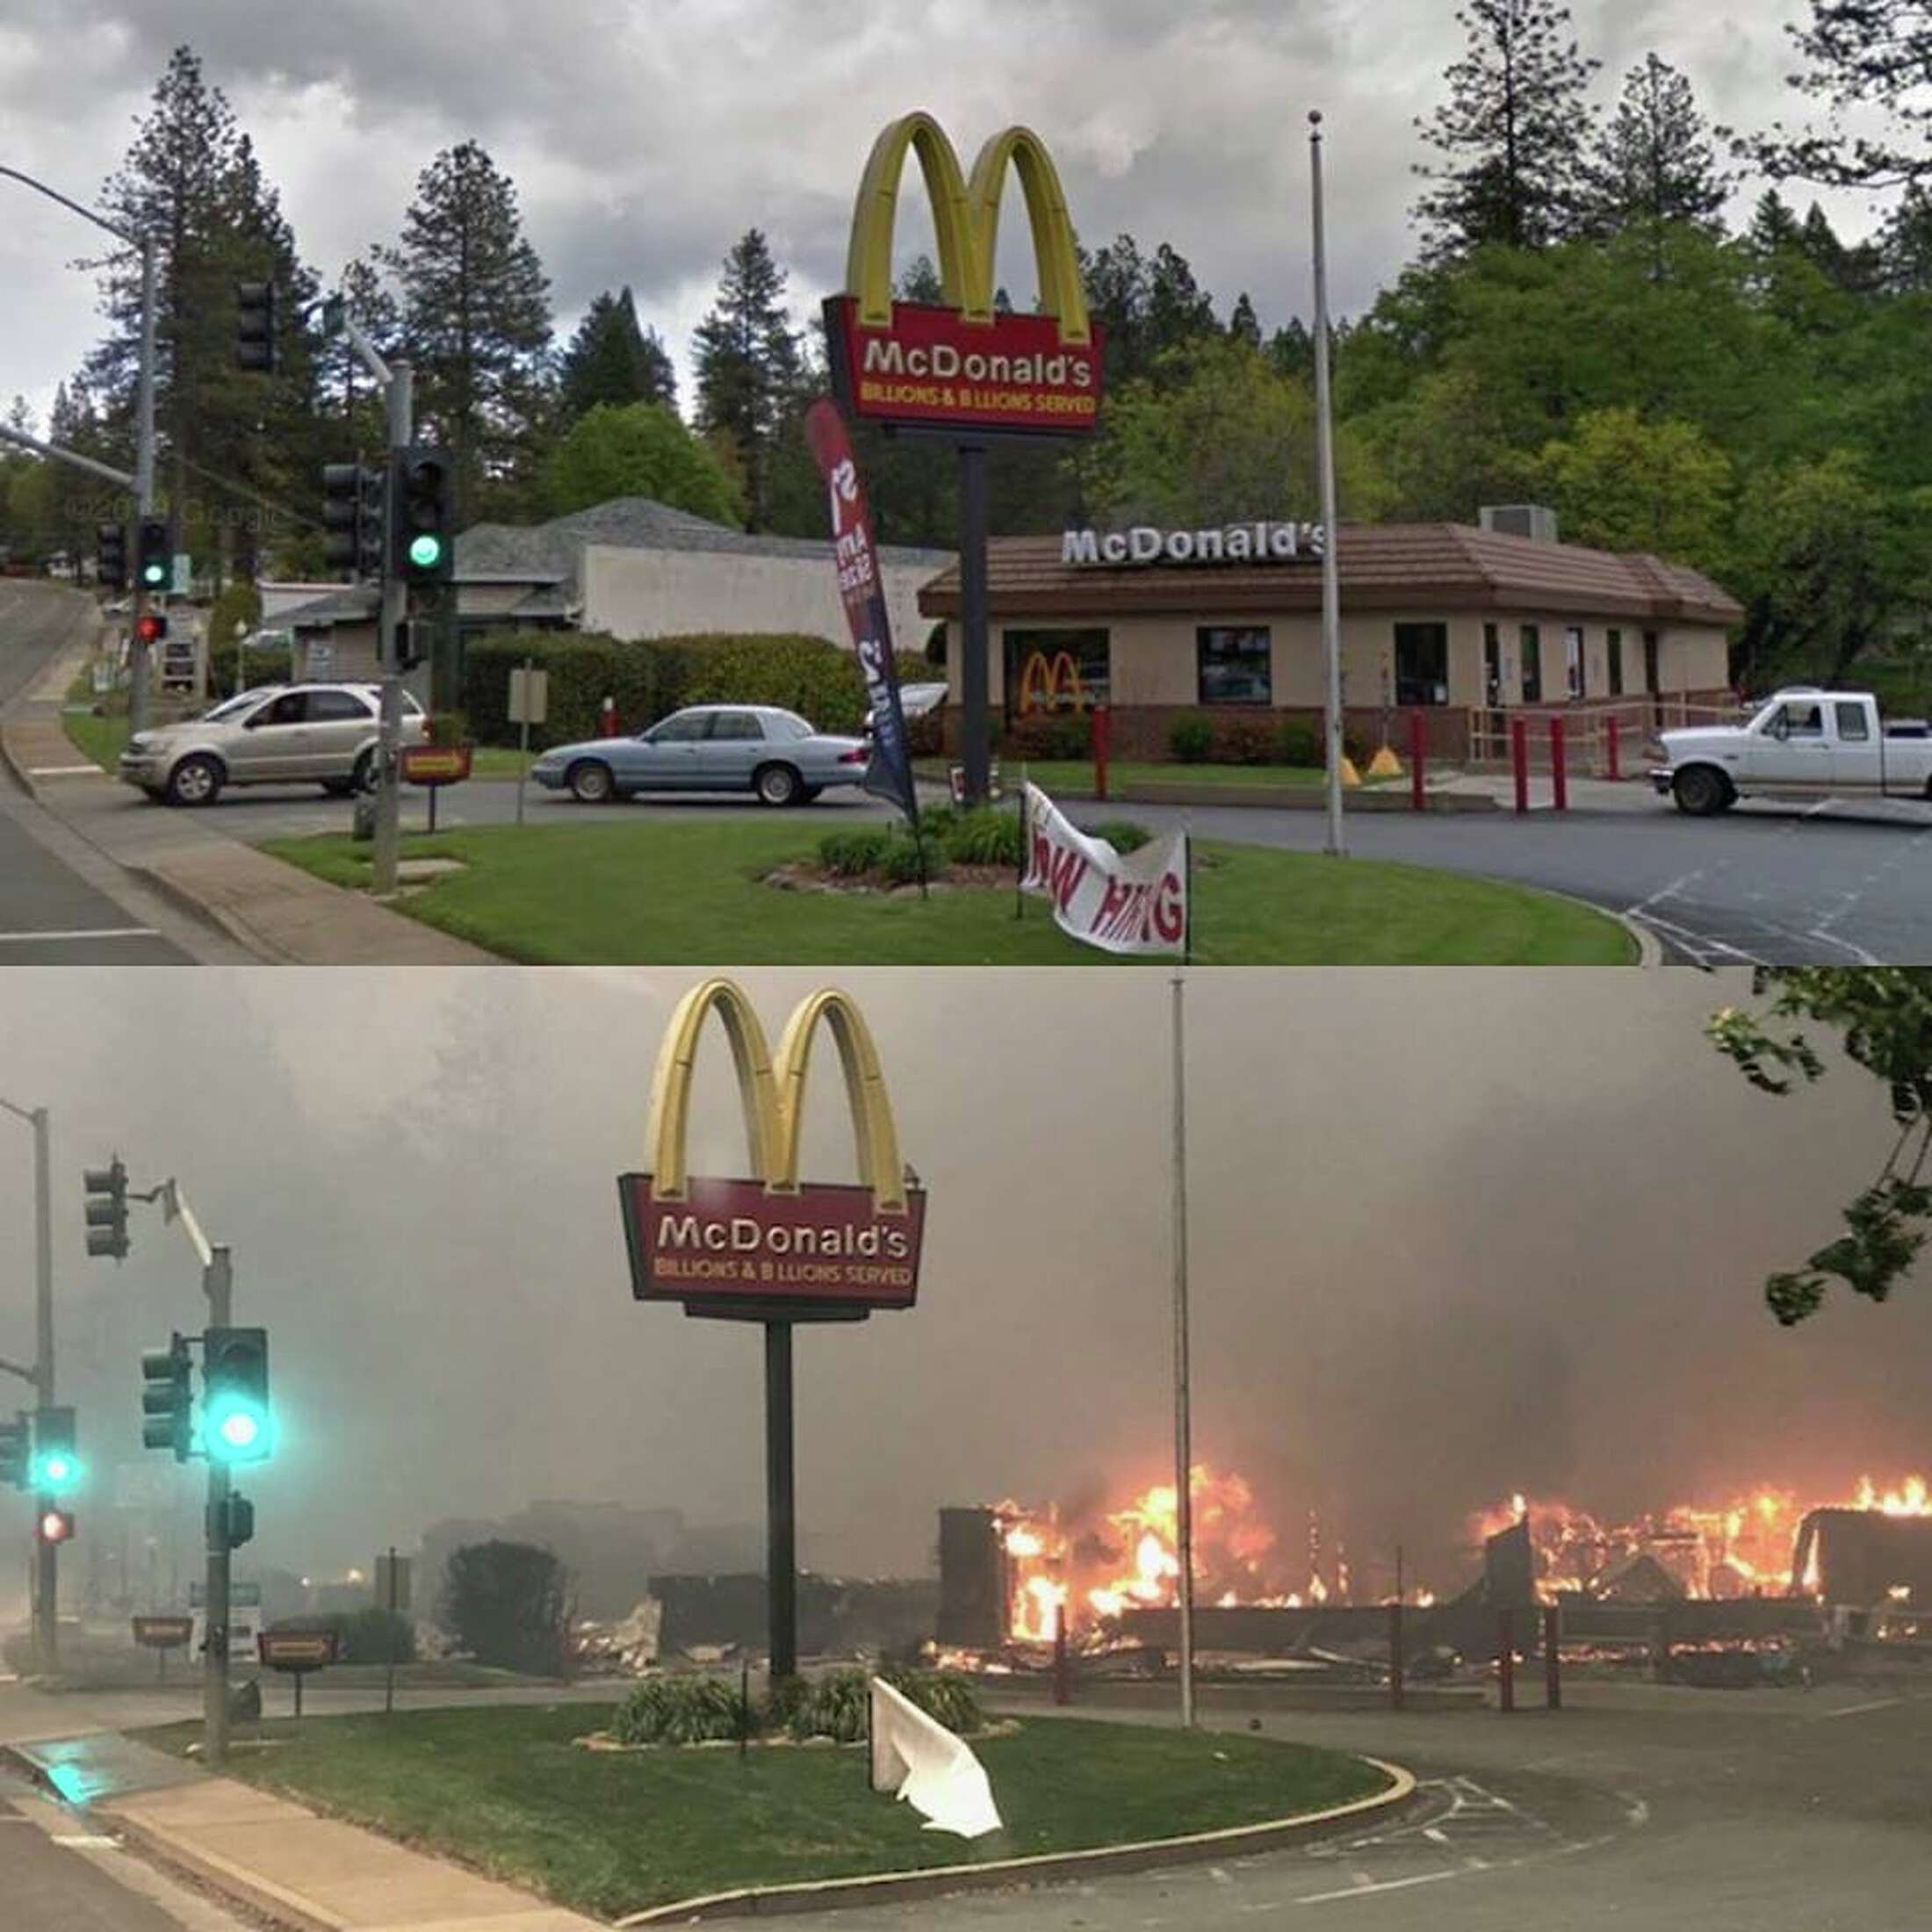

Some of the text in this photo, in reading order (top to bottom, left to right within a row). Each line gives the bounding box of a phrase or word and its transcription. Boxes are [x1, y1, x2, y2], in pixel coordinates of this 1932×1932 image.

[863, 339, 1092, 386] McDonald's
[942, 389, 955, 407] &
[1034, 394, 1095, 415] SERVED
[1061, 522, 1325, 563] McDonald's
[659, 1215, 908, 1257] McDonald's
[740, 1261, 756, 1279] &
